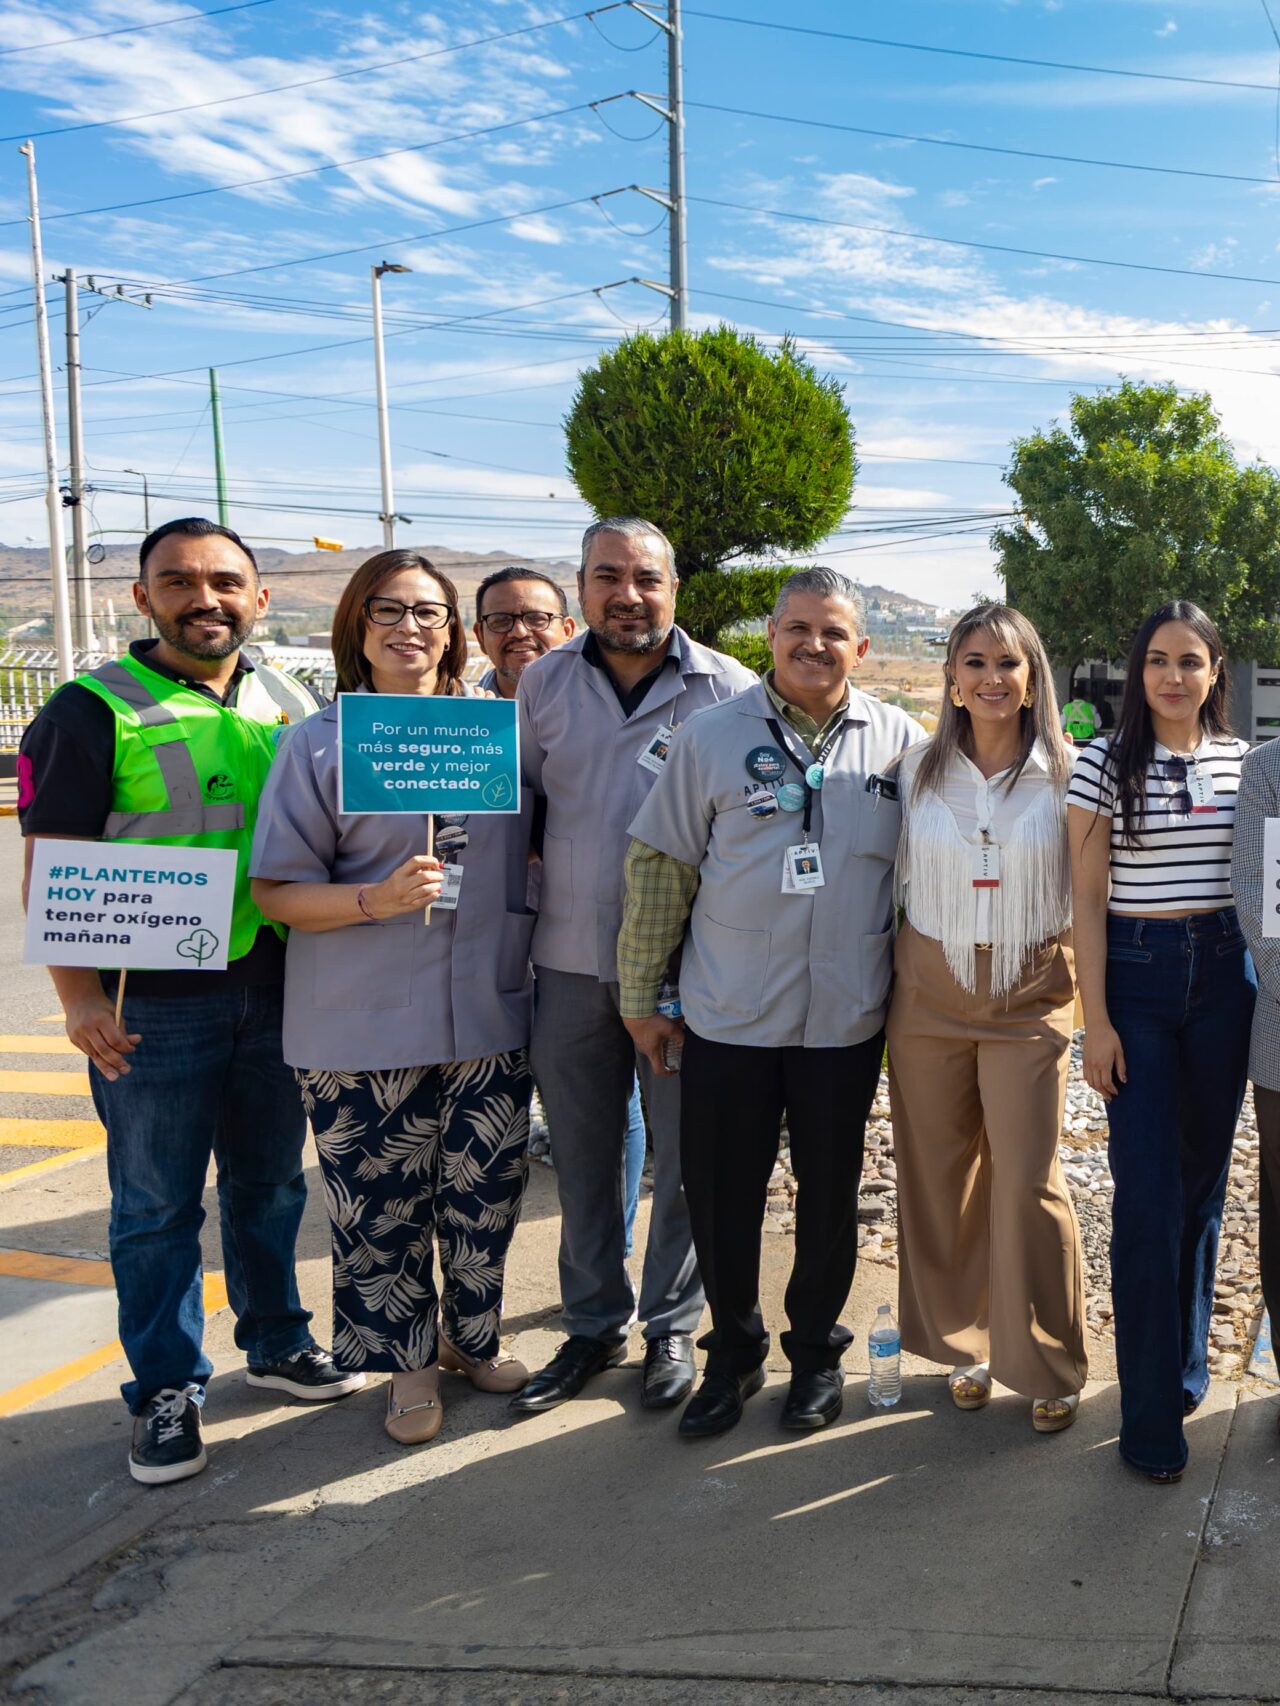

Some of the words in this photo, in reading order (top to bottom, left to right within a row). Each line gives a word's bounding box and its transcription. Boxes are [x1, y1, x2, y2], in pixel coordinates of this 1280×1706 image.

[372, 722, 402, 735] Por
[407, 725, 428, 736] un
[433, 725, 489, 737] mundo
[358, 740, 393, 753] más
[398, 743, 466, 756] seguro,
[471, 743, 503, 755] más
[372, 759, 426, 771] verde
[430, 762, 440, 774] y
[445, 760, 491, 774] mejor
[383, 777, 480, 790] conectado
[744, 778, 785, 796] APTIV
[49, 866, 209, 886] #PLANTEMOS
[47, 886, 96, 901] HOY
[103, 892, 152, 905] para
[45, 908, 107, 923] tener
[113, 911, 202, 928] oxígeno
[43, 929, 131, 944] mañana
